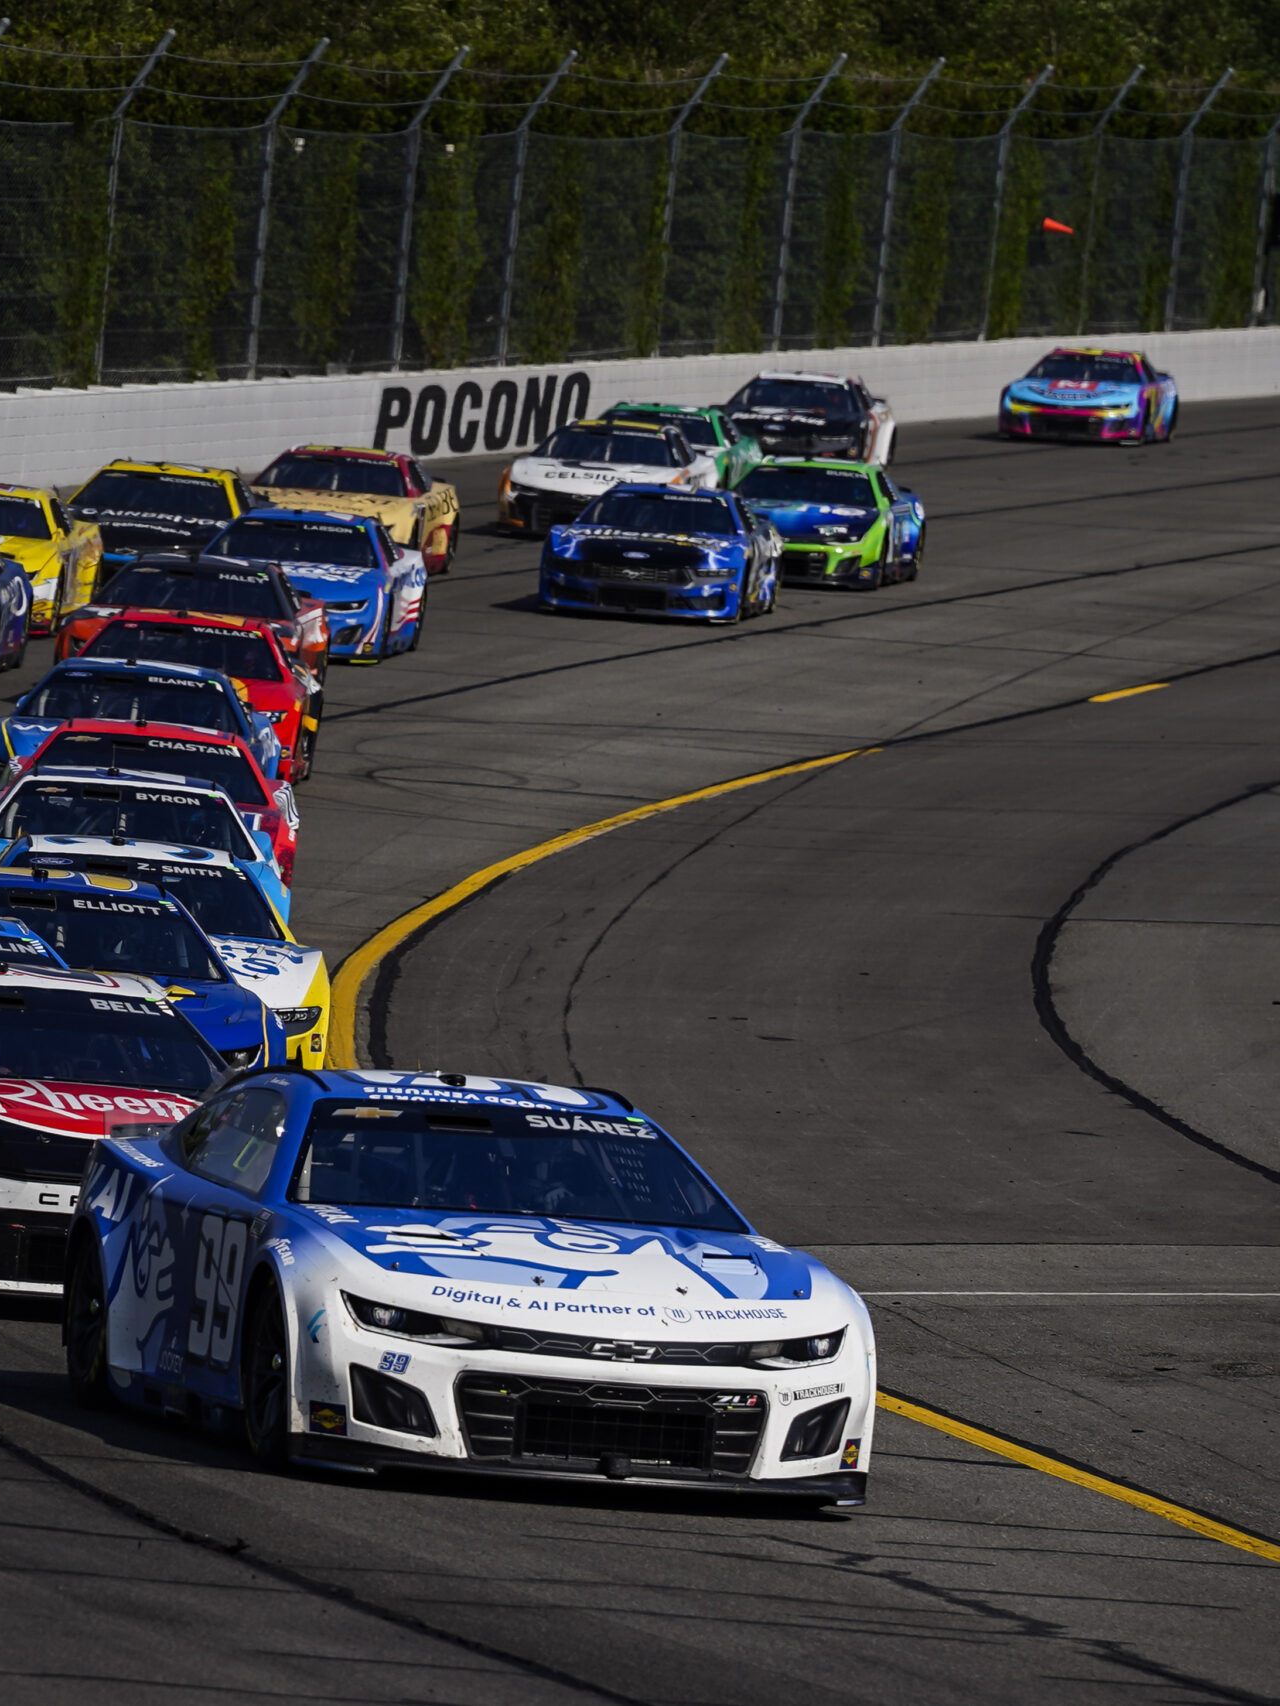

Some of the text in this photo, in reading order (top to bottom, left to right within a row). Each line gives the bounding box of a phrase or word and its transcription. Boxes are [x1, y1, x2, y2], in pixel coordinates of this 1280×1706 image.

[373, 371, 591, 456] POCONO
[303, 524, 353, 534] LARSON
[219, 572, 265, 585] HALEY
[192, 625, 259, 639] WALLACE
[148, 676, 206, 689] BLANEY
[148, 738, 238, 757] CHASTAIN
[135, 792, 201, 806] BYRON
[136, 862, 223, 878] Z. SMITH
[73, 899, 162, 916] ELLIOTT
[90, 998, 161, 1016] BELL
[363, 1086, 481, 1102] VENTURES
[524, 1114, 659, 1140] SUÁREZ
[187, 1213, 248, 1363] 99
[431, 1285, 656, 1317] Digital & AI Partner of
[696, 1307, 788, 1321] TRACKHOUSE
[378, 1350, 412, 1375] 99
[794, 1384, 839, 1400] TRACKHOUSE
